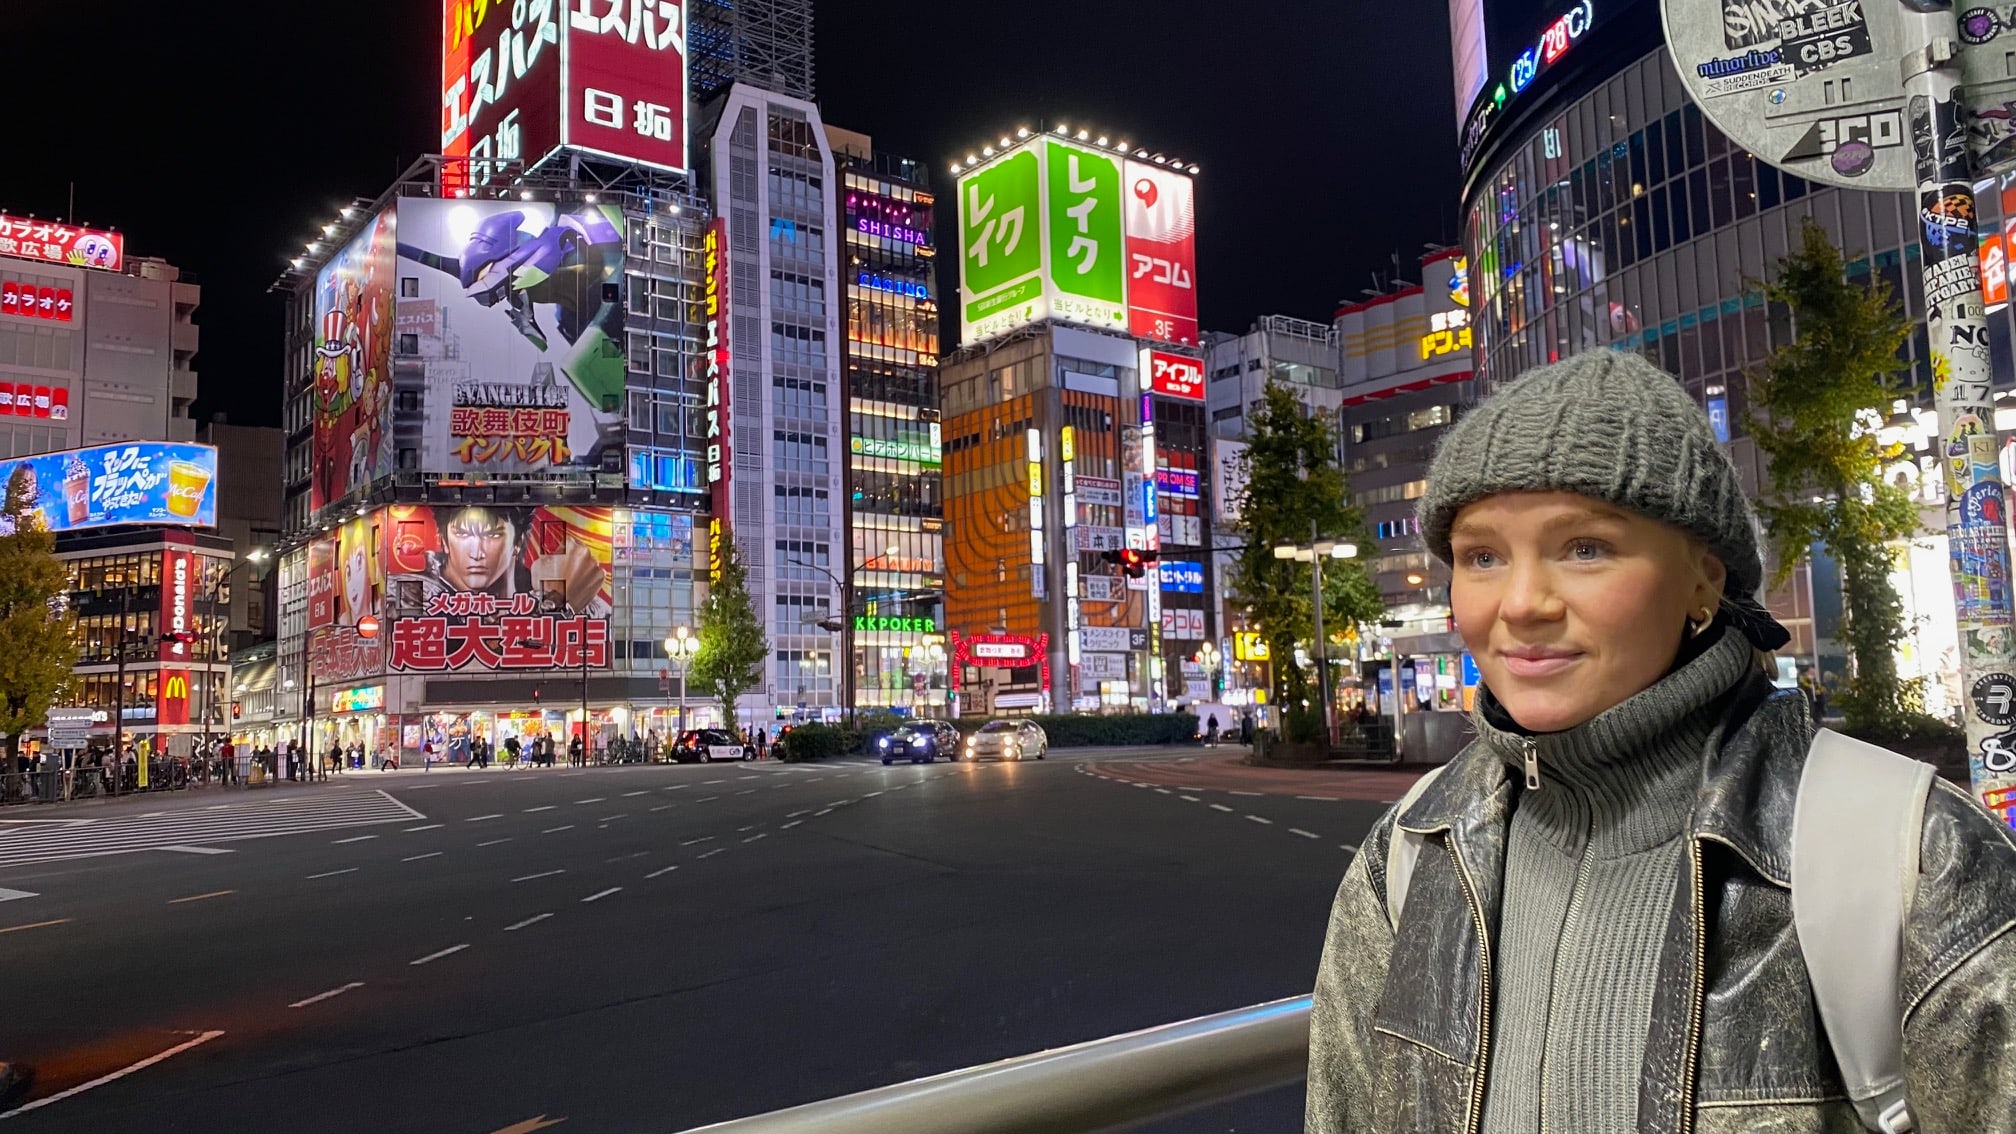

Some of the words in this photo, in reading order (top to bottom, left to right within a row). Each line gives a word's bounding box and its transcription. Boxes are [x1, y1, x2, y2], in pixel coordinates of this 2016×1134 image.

[1781, 2, 1863, 41] BLEEK
[1800, 35, 1854, 64] CBS
[968, 183, 1025, 268] レイク
[1066, 154, 1098, 275] レイク
[859, 218, 926, 246] SHISHA
[705, 230, 718, 316] パチンコ
[1132, 253, 1192, 289] アコム
[858, 273, 929, 300] CASINO
[3, 292, 72, 312] カラオケ
[1154, 319, 1174, 337] 3F
[706, 319, 720, 436] エスパス
[1154, 359, 1203, 385] アイフル
[453, 384, 570, 408] EVANGELION
[452, 408, 571, 436] 歌舞伎町
[450, 435, 571, 466] インパクト
[1157, 470, 1196, 489] PROMISE
[171, 558, 187, 655] MDonald's
[427, 592, 535, 617] メガホール
[855, 616, 935, 632] KKPOKER
[1162, 612, 1203, 631] アコム
[389, 616, 607, 671] 超大型店
[1131, 633, 1146, 646] 3F
